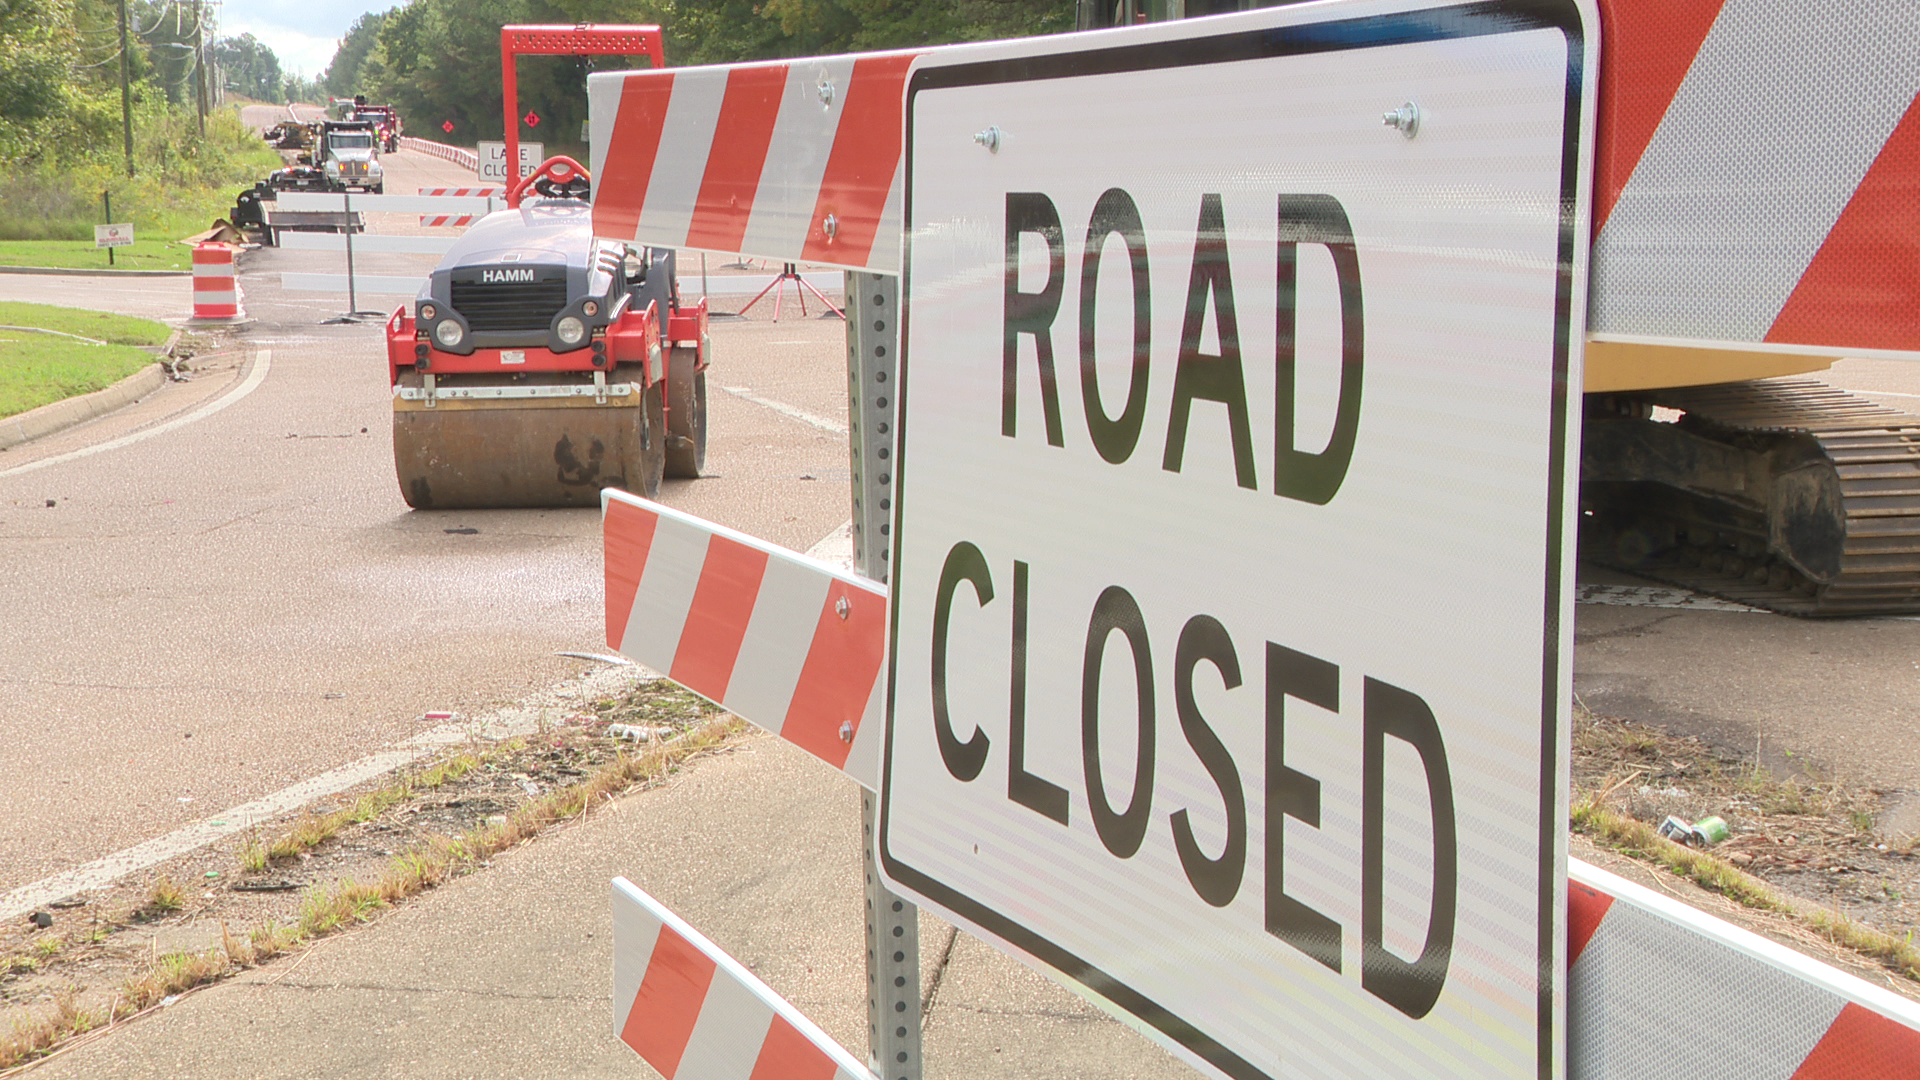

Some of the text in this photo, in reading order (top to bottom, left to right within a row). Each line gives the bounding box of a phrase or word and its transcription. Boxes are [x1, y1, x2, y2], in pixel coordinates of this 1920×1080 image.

[491, 147, 528, 160] LAE
[484, 163, 537, 177] CLOED
[482, 268, 535, 283] HAMM
[1002, 187, 1365, 506] ROAD
[931, 540, 1458, 1020] CLOSED
